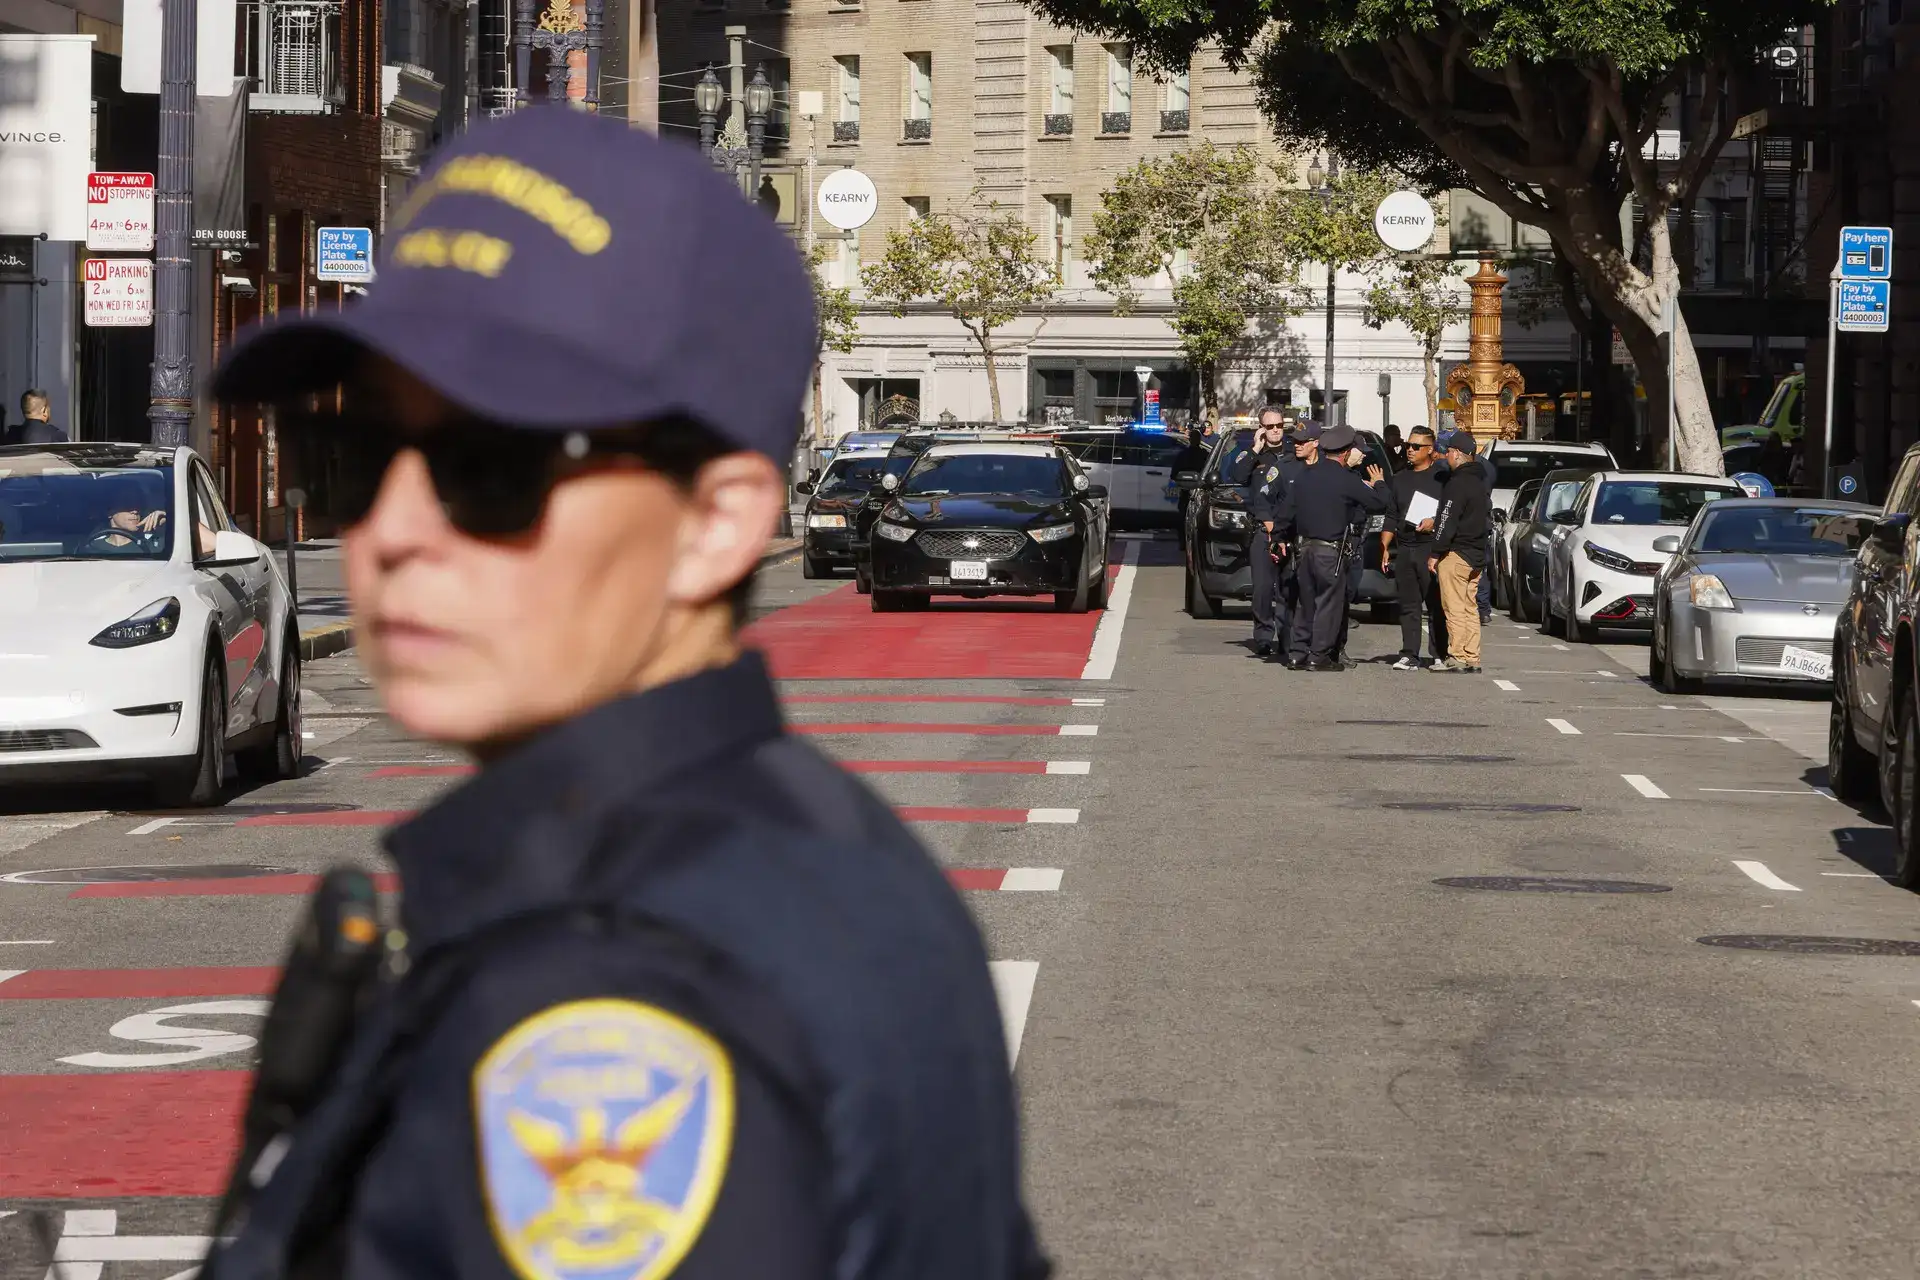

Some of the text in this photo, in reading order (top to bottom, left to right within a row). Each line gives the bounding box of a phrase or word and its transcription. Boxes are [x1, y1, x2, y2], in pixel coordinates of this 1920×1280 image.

[94, 176, 146, 184] TOW-AWAY
[88, 186, 150, 201] NO STOPPING
[825, 194, 870, 202] KEARNY
[1382, 216, 1426, 226] KEARNY
[192, 230, 247, 239] DEN GOOSE
[322, 231, 355, 242] Pay by
[1844, 232, 1888, 244] Pay here
[322, 241, 358, 250] License
[322, 250, 347, 259] Plate
[88, 262, 148, 278] NO PARKING
[1843, 284, 1875, 294] Pay by
[1843, 293, 1876, 302] License
[88, 300, 149, 310] MON WED FRI SAT
[1843, 302, 1866, 311] Plate
[1843, 314, 1883, 322] 44000003
[1845, 480, 1852, 490] P
[1784, 656, 1826, 675] 9AJB666
